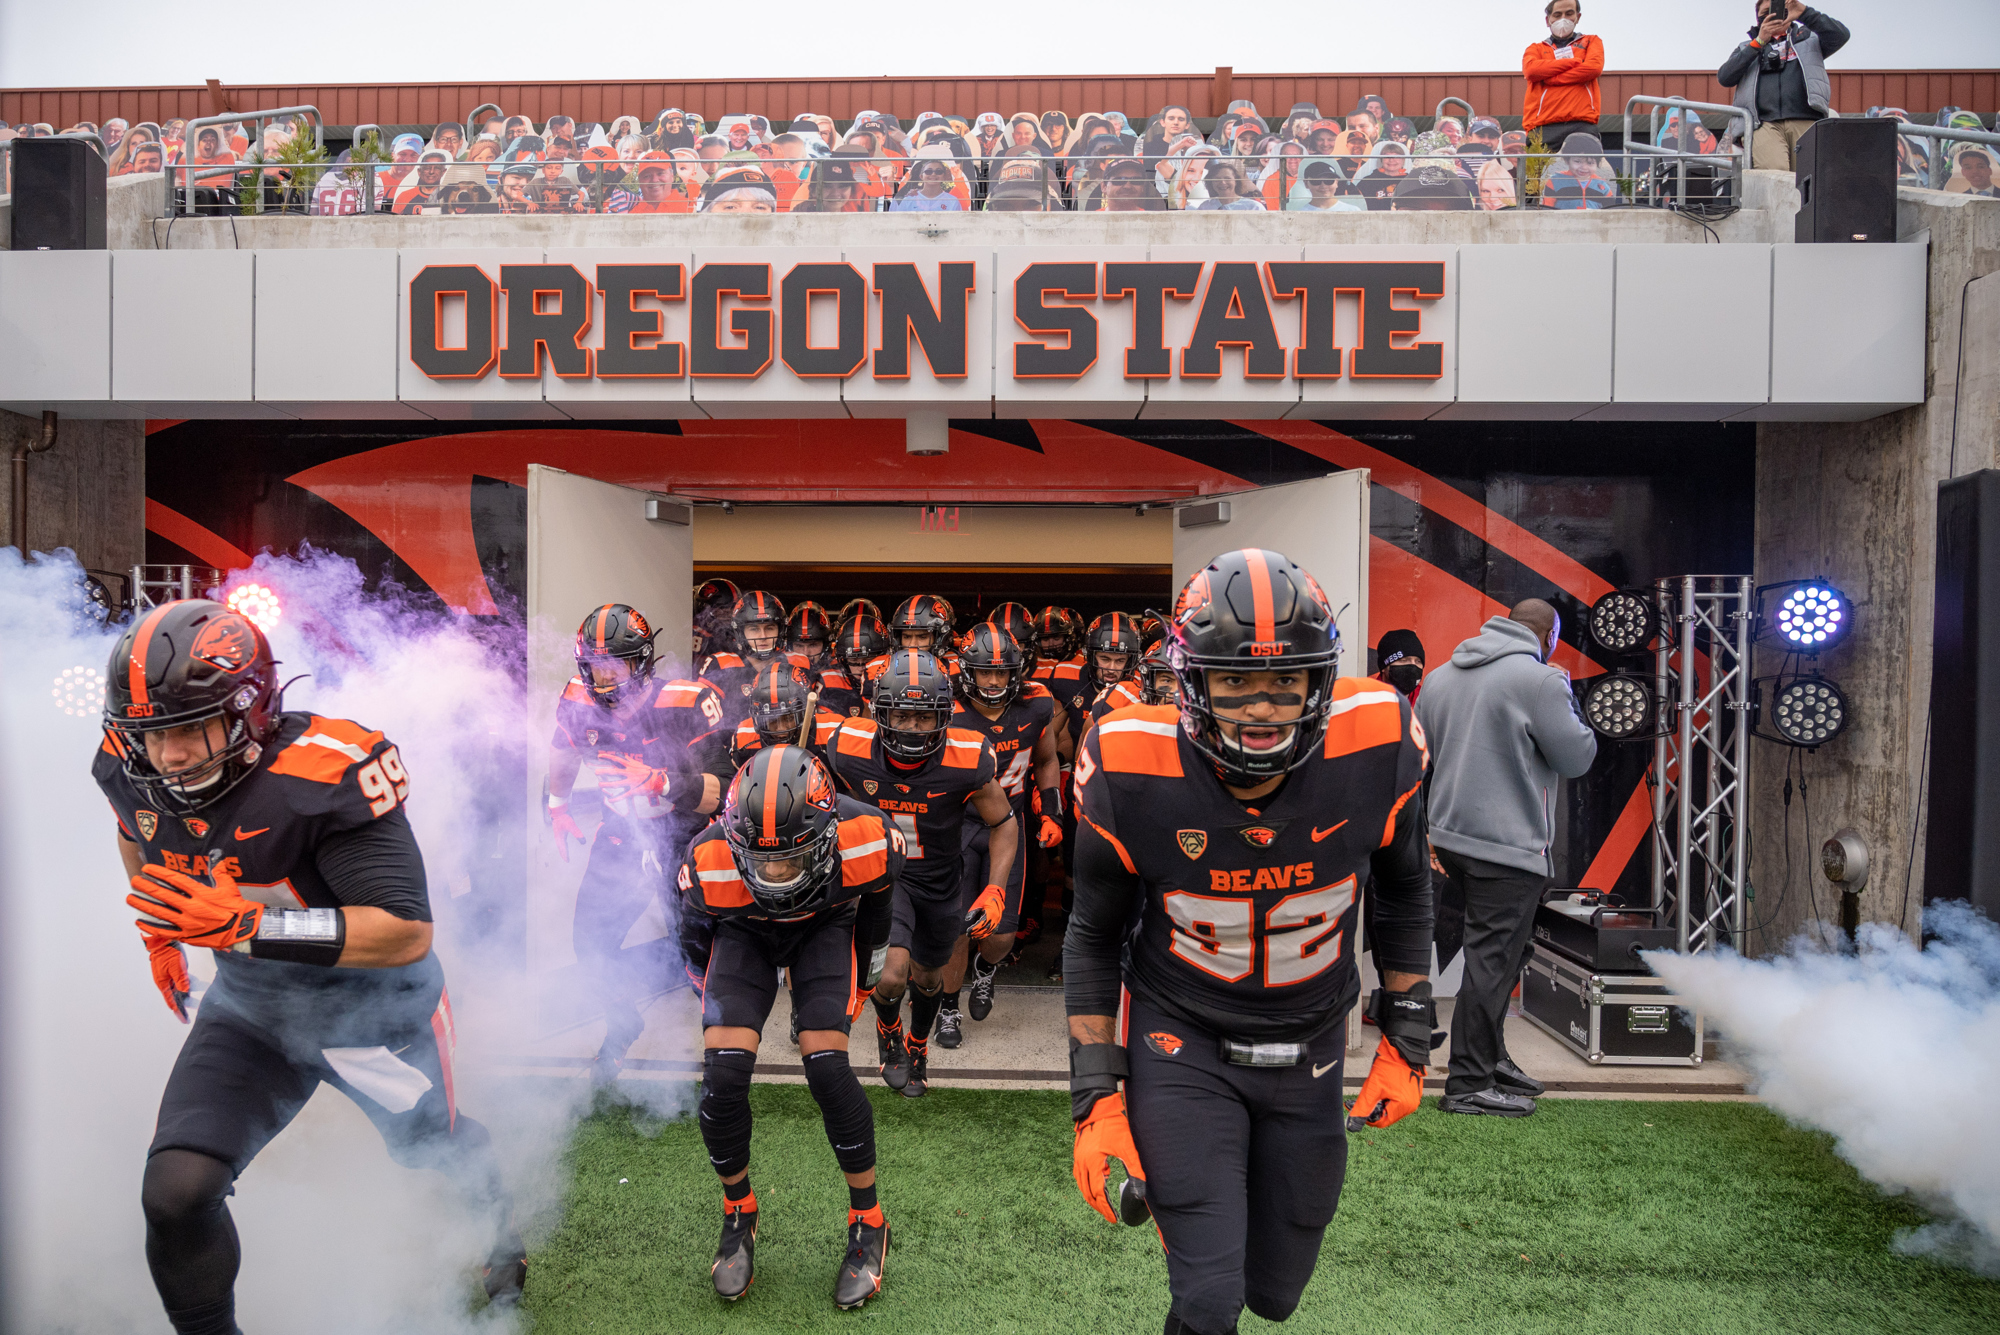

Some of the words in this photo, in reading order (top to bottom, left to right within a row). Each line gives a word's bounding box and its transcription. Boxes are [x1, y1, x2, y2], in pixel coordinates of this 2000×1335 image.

[319, 190, 359, 216] 66
[409, 261, 976, 379] OREGON
[1013, 261, 1446, 380] STATE
[1251, 642, 1284, 657] OSU
[127, 704, 154, 718] OSU
[357, 745, 410, 818] 99
[878, 799, 928, 814] BEAVS
[758, 837, 780, 847] OSU
[1187, 842, 1200, 854] 12
[160, 849, 243, 878] BEAS
[1209, 862, 1314, 892] BEAVS
[1163, 872, 1358, 988] 92
